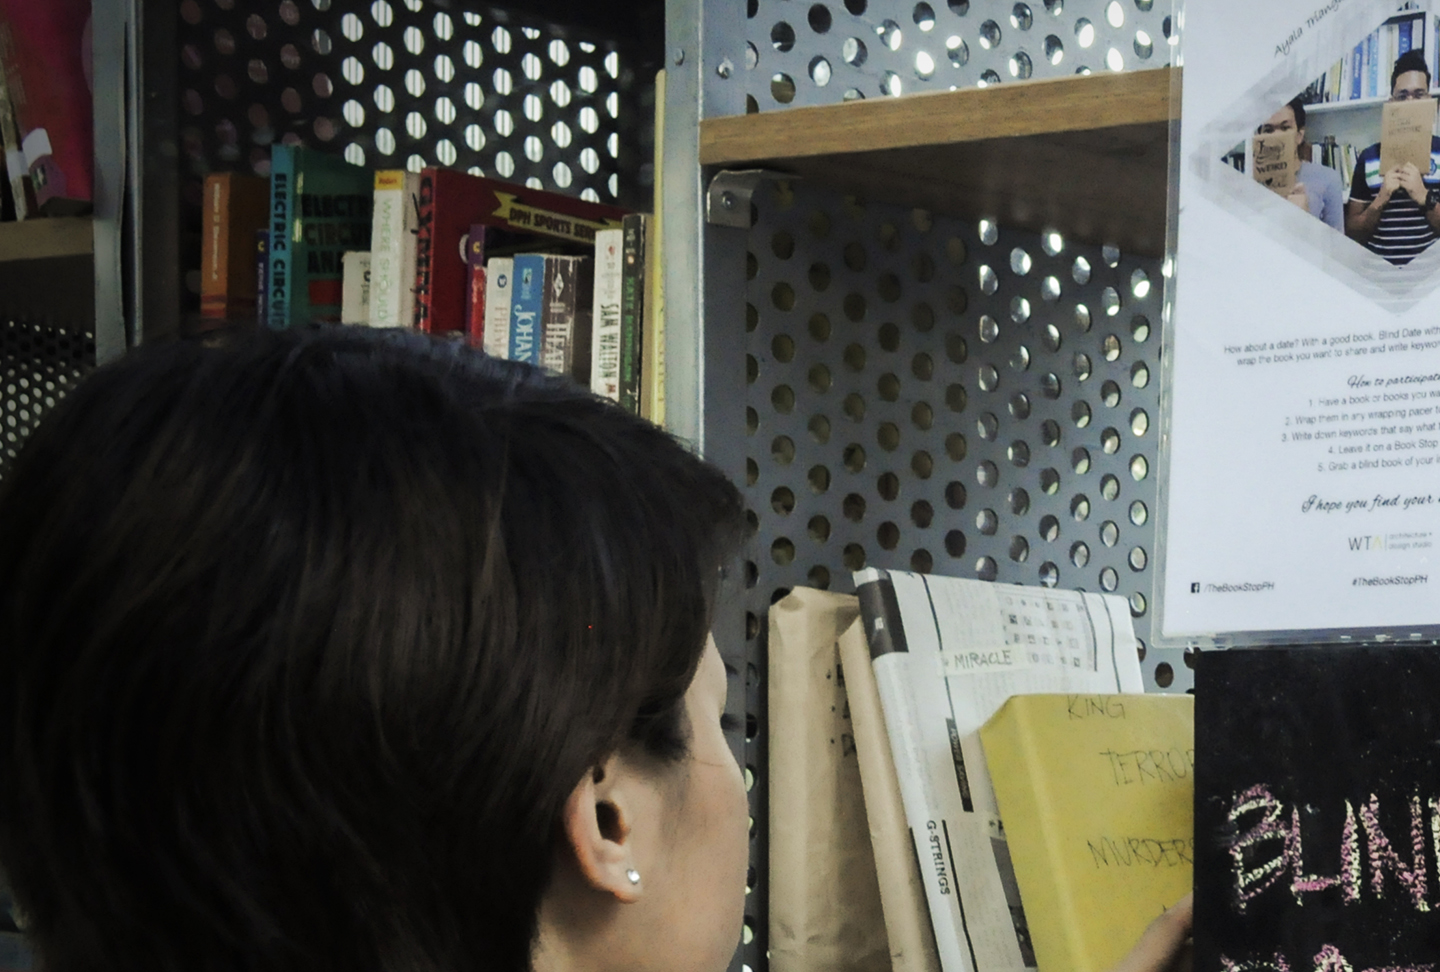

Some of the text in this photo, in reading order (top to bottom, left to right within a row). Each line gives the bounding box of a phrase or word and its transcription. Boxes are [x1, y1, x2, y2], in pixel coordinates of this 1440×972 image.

[273, 173, 288, 251] ELECTRIC
[508, 207, 573, 235] DPH SPORTS
[380, 198, 393, 252] WHERE
[376, 258, 392, 320] SHOULD
[599, 303, 619, 329] SAM
[1223, 344, 1242, 355] How
[1244, 342, 1267, 353] about
[1276, 338, 1299, 350] date?
[1301, 337, 1320, 348] With
[1329, 333, 1351, 348] good
[1378, 328, 1400, 341] Blind
[1402, 327, 1422, 339] Date
[598, 332, 619, 379] WALTON
[1236, 356, 1257, 367] wrap
[1258, 353, 1272, 365] the
[1273, 351, 1294, 363] book
[1295, 351, 1312, 364] you
[1312, 349, 1333, 360] want
[1334, 348, 1343, 358] to
[1345, 346, 1368, 357] share
[1369, 344, 1387, 355] and
[1388, 342, 1409, 354] write
[1374, 376, 1385, 387] to
[1318, 396, 1340, 407] Have
[1349, 393, 1371, 405] book
[1372, 393, 1382, 403] or
[1382, 391, 1410, 403] books
[1411, 390, 1428, 402] you
[1295, 414, 1317, 426] Wrap
[1318, 412, 1340, 424] them
[1341, 411, 1349, 422] in
[1350, 412, 1366, 423] any
[1367, 408, 1407, 422] wrapping
[1408, 406, 1433, 419] paper
[1291, 430, 1313, 442] Write
[1314, 428, 1338, 440] down
[1338, 426, 1379, 440] keywords
[1380, 424, 1397, 436] that
[1398, 423, 1414, 435] say
[1415, 421, 1437, 434] what
[1338, 443, 1364, 455] Leave
[1372, 442, 1385, 453] on
[1394, 439, 1417, 452] Book
[1418, 437, 1439, 450] Stop
[1327, 460, 1349, 472] Grab
[1358, 458, 1380, 470] blind
[1380, 456, 1403, 469] book
[1404, 455, 1415, 467] of
[1415, 456, 1435, 468] your
[1315, 497, 1344, 514] hope
[1344, 499, 1369, 514] you
[1368, 493, 1401, 512] find
[1402, 494, 1435, 511] your
[1351, 574, 1429, 587] #TheBookStopPH
[953, 650, 1013, 670] MIRACLE
[1067, 693, 1126, 720] KING
[926, 819, 951, 895] G-STRINGS
